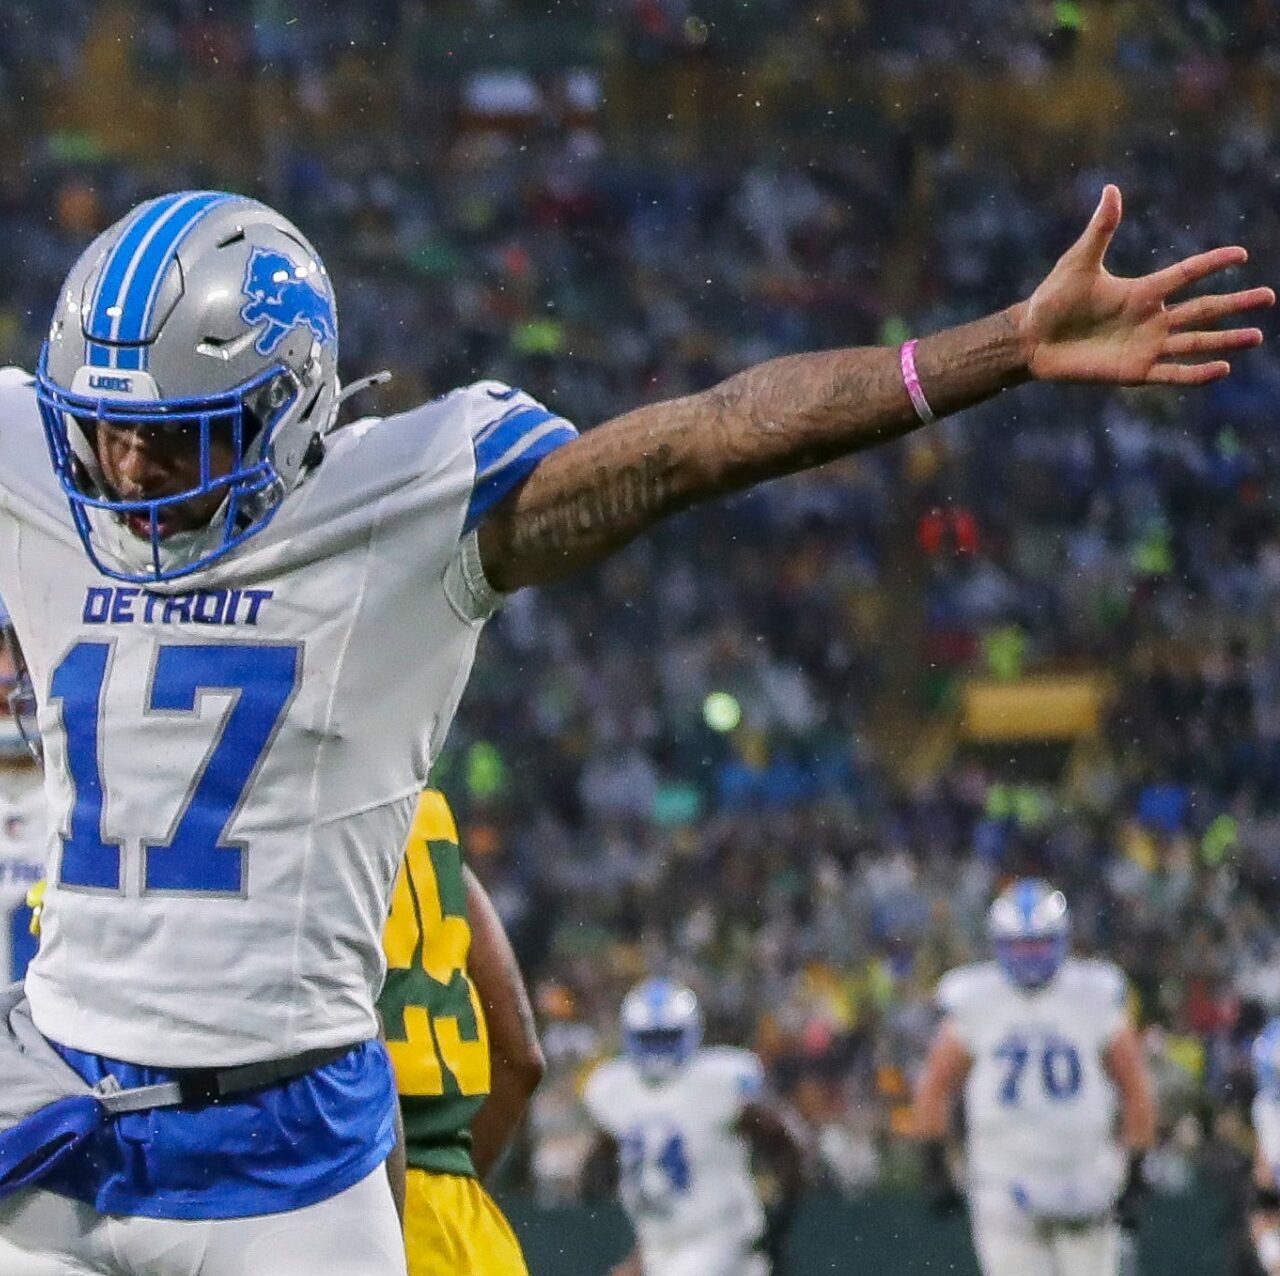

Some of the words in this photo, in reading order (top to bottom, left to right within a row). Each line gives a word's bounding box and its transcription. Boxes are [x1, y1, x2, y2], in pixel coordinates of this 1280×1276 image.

[82, 586, 273, 625] DETROIT
[47, 636, 305, 899] 17
[994, 1030, 1083, 1106] 70
